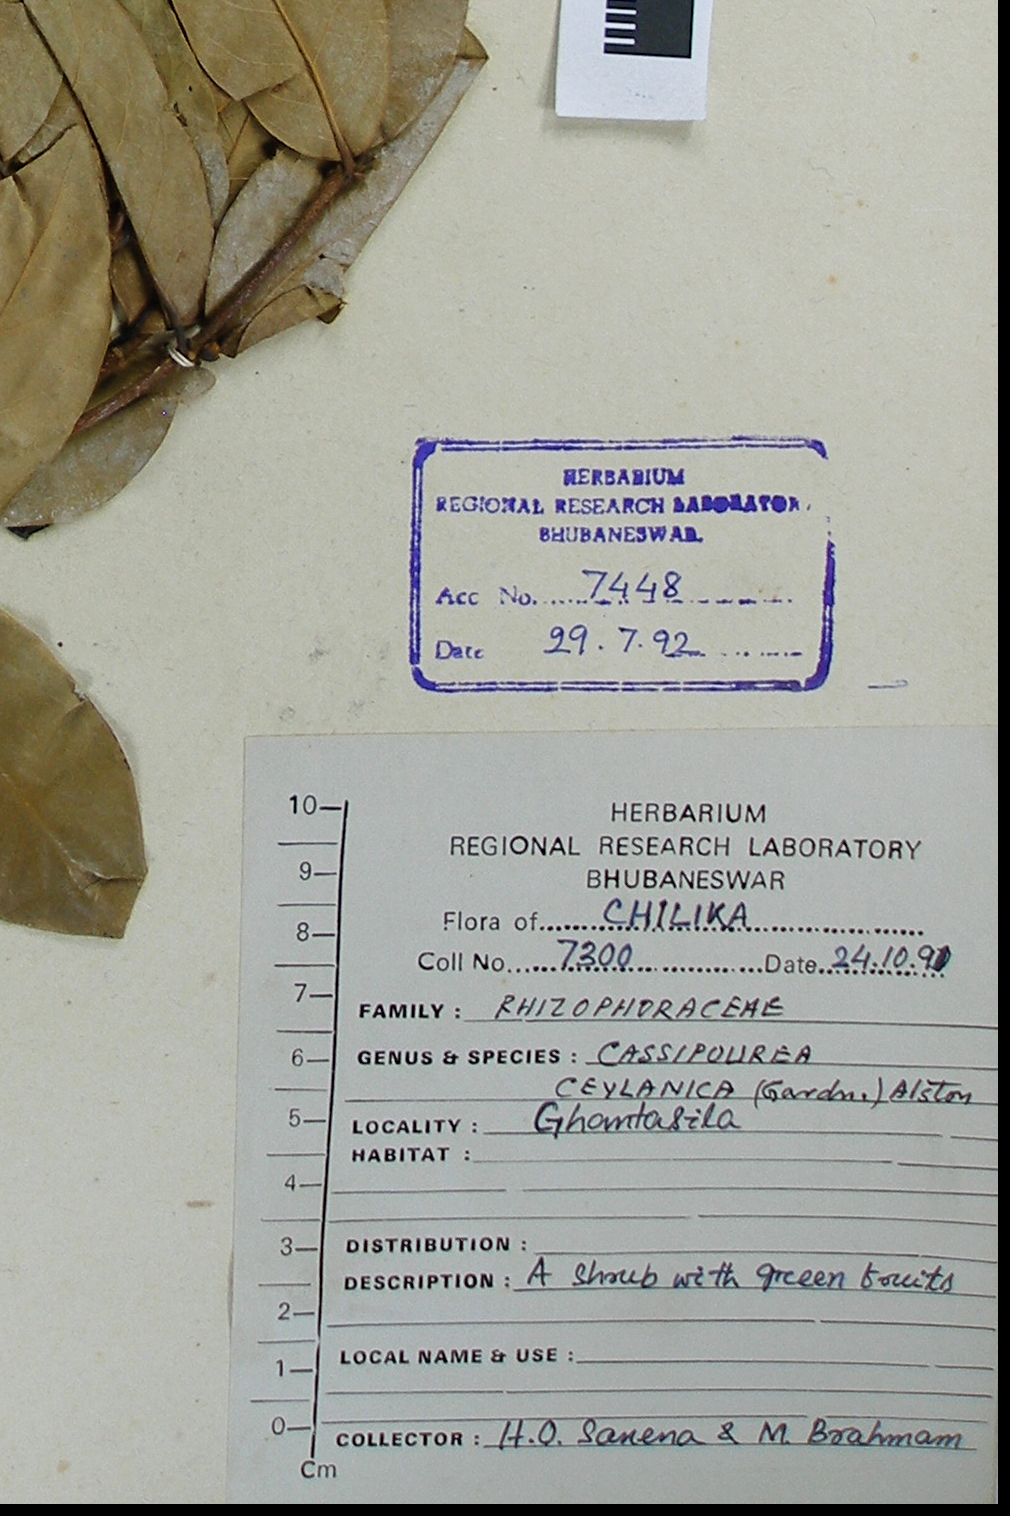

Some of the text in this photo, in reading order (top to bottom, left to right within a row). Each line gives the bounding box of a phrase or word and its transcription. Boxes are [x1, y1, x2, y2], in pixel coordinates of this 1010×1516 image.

[435, 496, 544, 515] REGIONAL
[555, 497, 665, 515] RESEARCH
[582, 569, 682, 600] 7448
[289, 795, 317, 816] 10
[611, 803, 766, 823] HERBARIUM
[451, 836, 922, 860] REGIONAL RESEARCH LABORATORY
[299, 863, 311, 883] 9
[587, 869, 785, 891] BHUBANESWAR
[444, 911, 501, 931] Flora
[604, 898, 749, 930] CHILIKA
[296, 922, 310, 941] 8
[418, 951, 463, 972] Coll
[557, 939, 633, 971] 7300
[765, 953, 818, 975] Date
[295, 984, 308, 1003] 7
[359, 1003, 444, 1019] FAMILY
[291, 1048, 305, 1068] 6
[358, 1051, 433, 1065] GENUS
[443, 1051, 459, 1064] &
[468, 1049, 561, 1064] SPECIES
[597, 1041, 812, 1066] CASSIPOUREA
[555, 1077, 734, 1100] CEYLANICA
[889, 1082, 972, 1105] Alston
[288, 1109, 302, 1129] 5
[352, 1119, 461, 1134] LOCALITY
[352, 1147, 450, 1162] HABITAT
[284, 1174, 297, 1193] 4
[280, 1237, 292, 1257] 3
[346, 1237, 510, 1253] DISTRIBUTION
[344, 1273, 494, 1290] DESCRIPTION
[527, 1256, 552, 1287] A
[673, 1265, 739, 1288] with
[756, 1263, 845, 1292] green
[278, 1303, 291, 1322] 2
[340, 1349, 410, 1364] LOCAL
[418, 1349, 483, 1364] NAME
[490, 1349, 507, 1363] &
[516, 1348, 558, 1363] USE
[271, 1417, 286, 1438] 0
[717, 1422, 740, 1445] &
[336, 1432, 463, 1447] COLLECTOR
[300, 1460, 336, 1479] Cm
